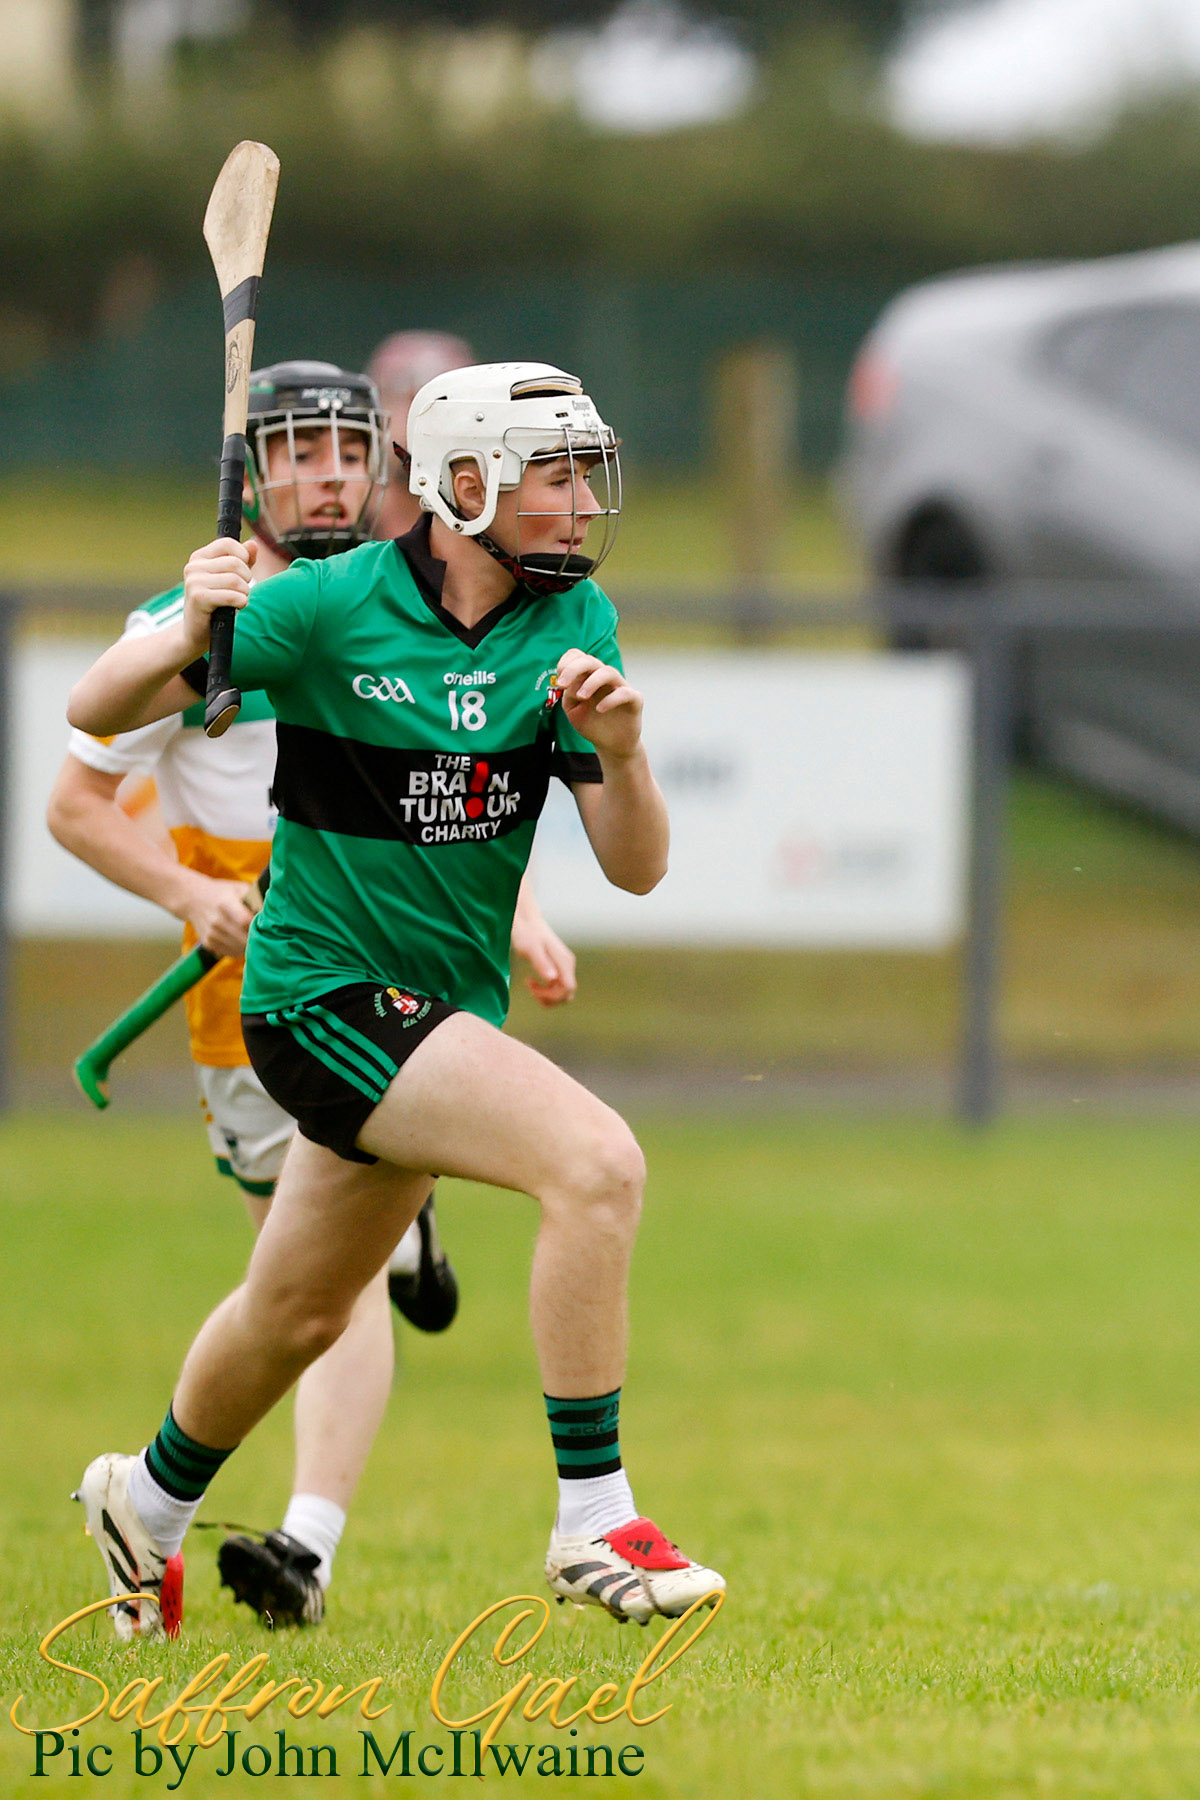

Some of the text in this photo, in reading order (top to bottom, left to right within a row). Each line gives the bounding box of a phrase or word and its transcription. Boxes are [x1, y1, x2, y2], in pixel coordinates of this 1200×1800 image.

[448, 690, 487, 731] 18
[434, 754, 471, 771] THE
[420, 820, 501, 843] CHARITY
